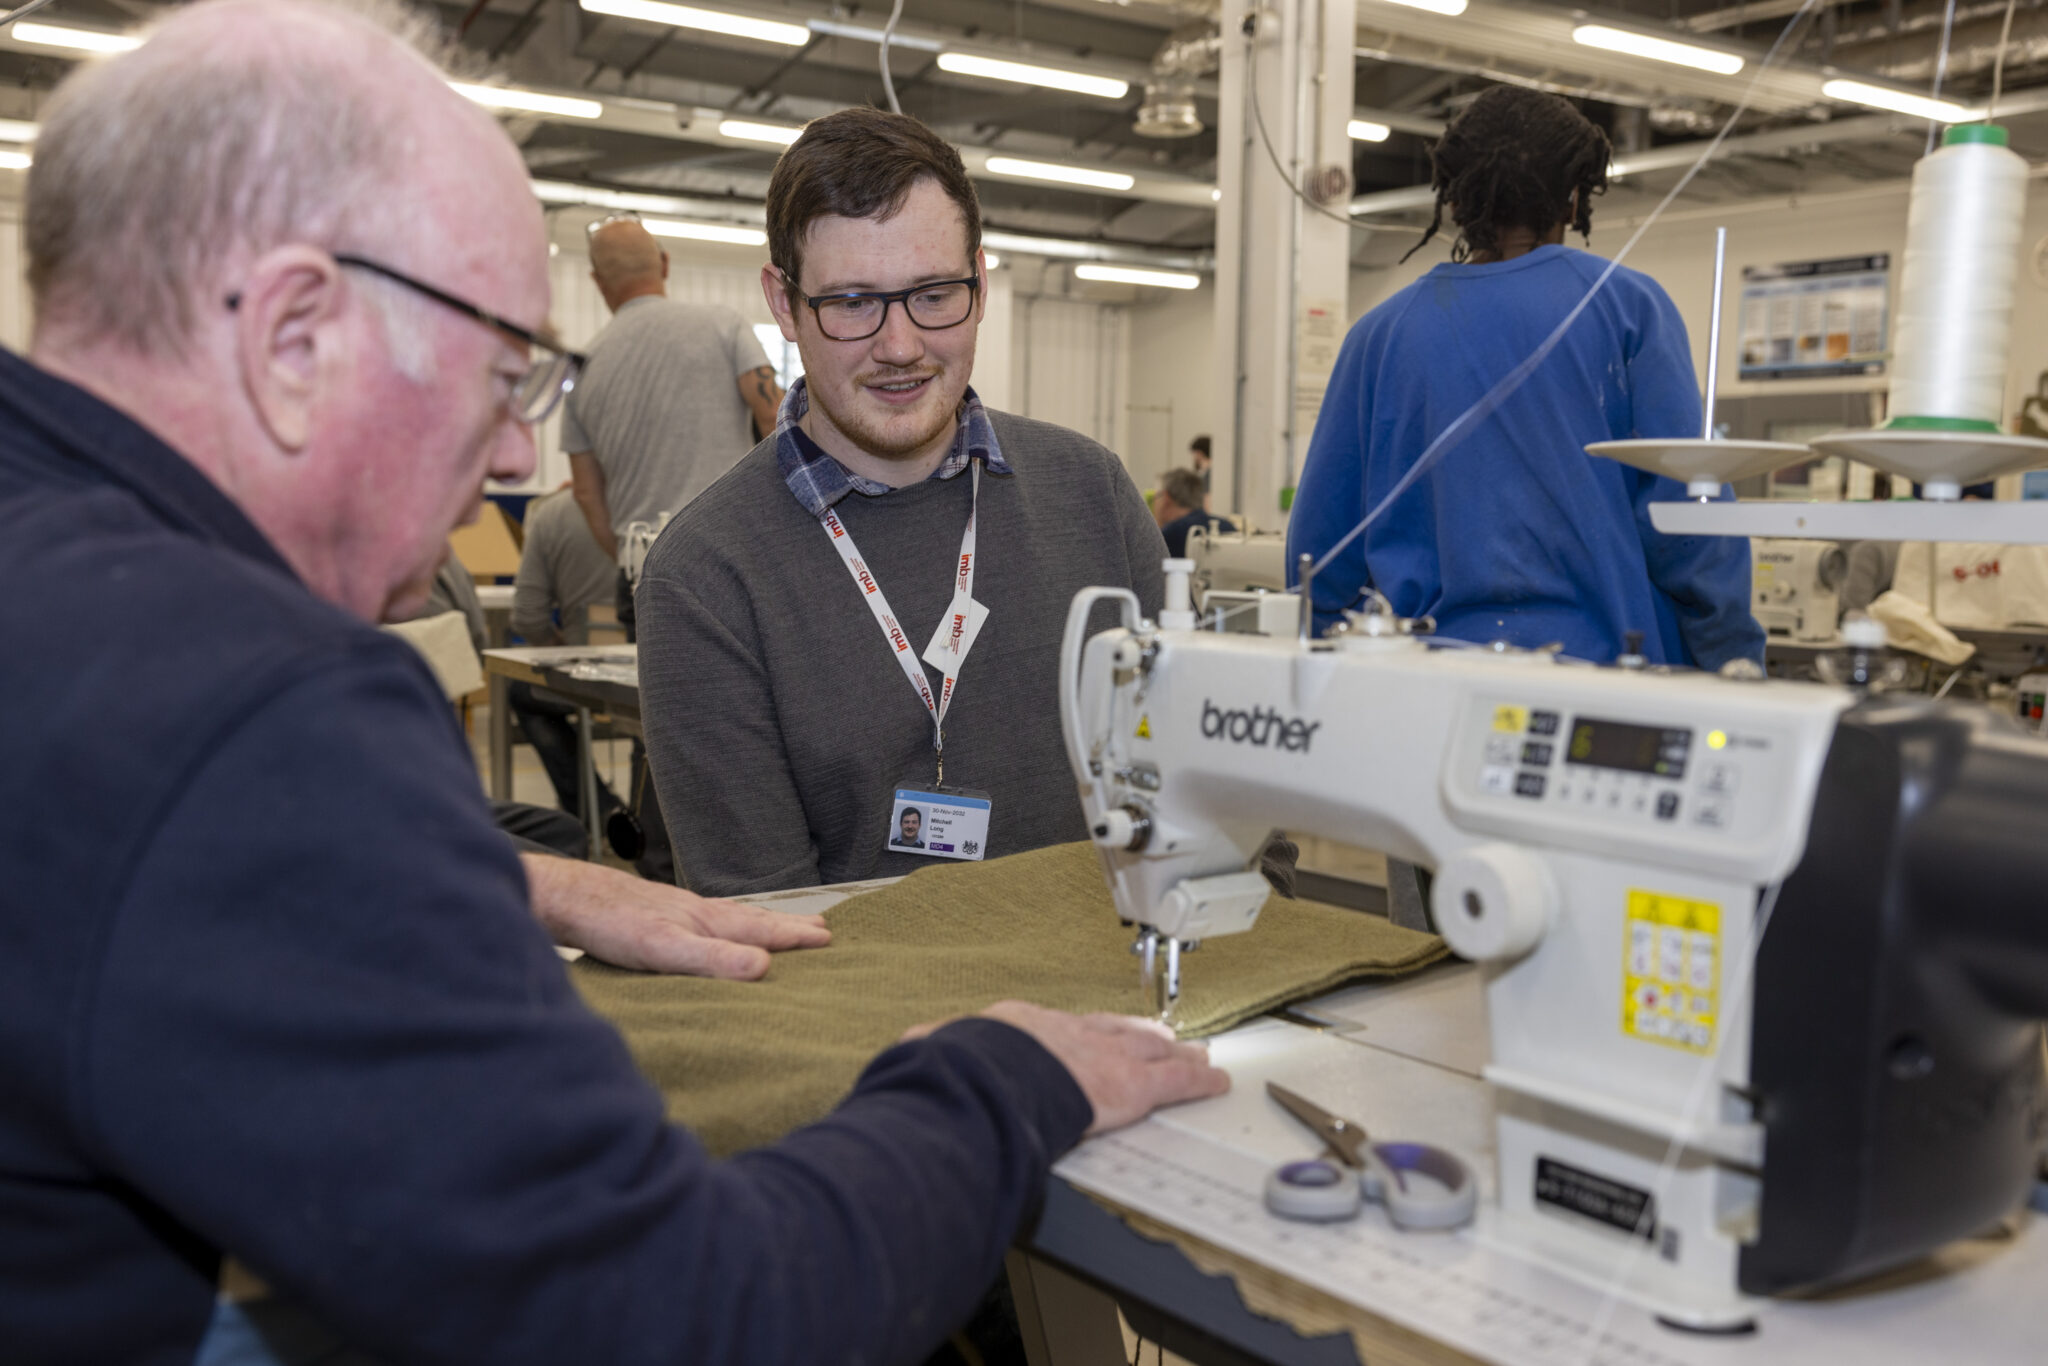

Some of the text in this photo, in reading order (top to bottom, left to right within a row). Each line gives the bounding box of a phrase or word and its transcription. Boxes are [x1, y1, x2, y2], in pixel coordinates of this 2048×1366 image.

[826, 515, 844, 539] imb
[958, 553, 973, 577] imb
[858, 570, 877, 595] imb
[951, 613, 967, 639] imb
[889, 627, 909, 653] imb
[943, 677, 955, 702] imb
[1201, 699, 1320, 753] brother
